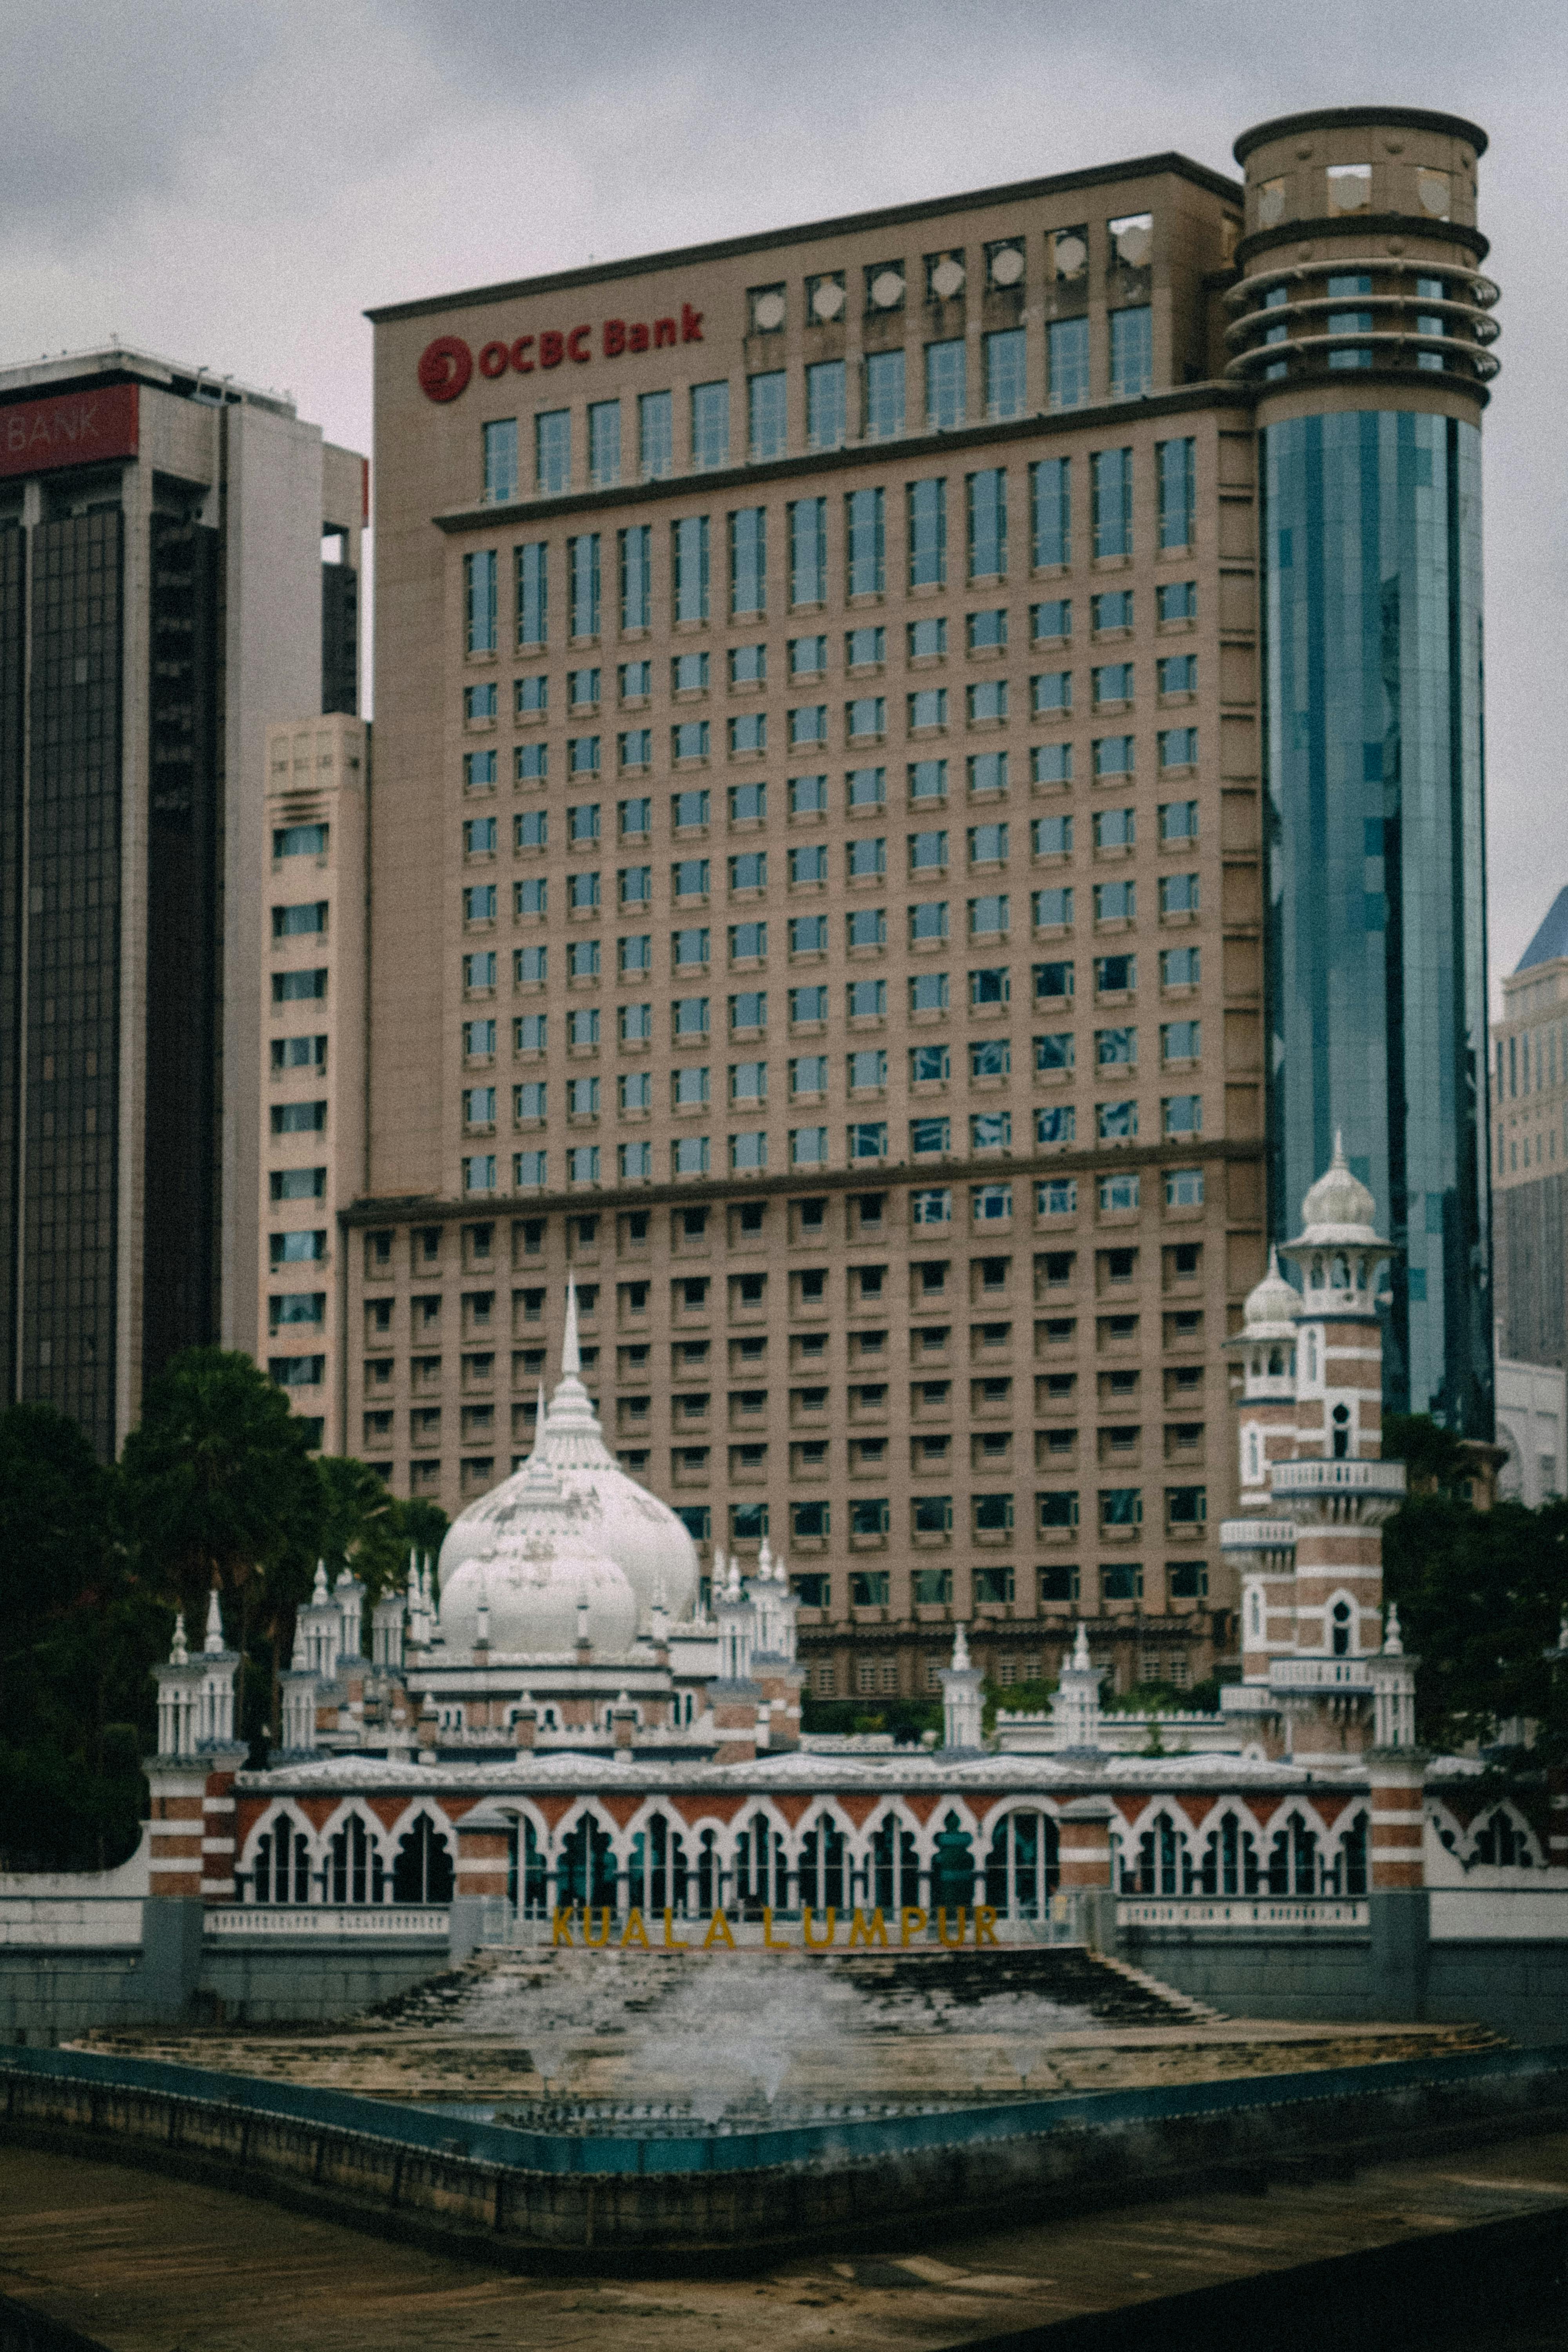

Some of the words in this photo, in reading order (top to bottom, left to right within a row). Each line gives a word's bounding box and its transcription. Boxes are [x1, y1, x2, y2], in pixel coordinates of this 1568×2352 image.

[479, 325, 591, 377] OCBC
[603, 303, 703, 358] Bank
[8, 403, 100, 452] BANK
[552, 1905, 736, 1949] KUALA
[763, 1904, 1000, 1950] LUMPUR
